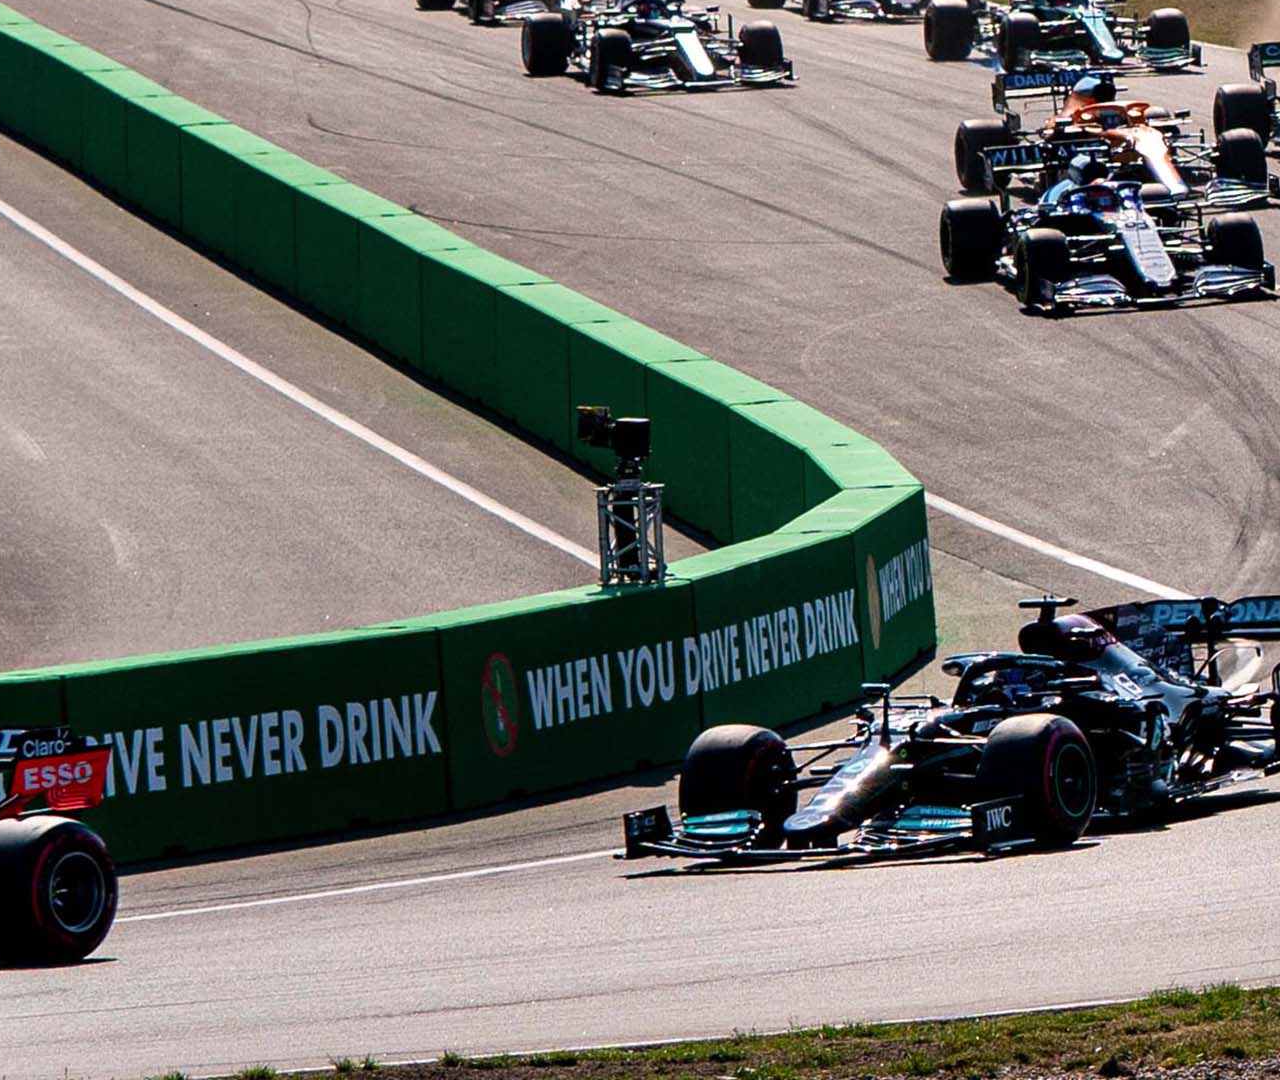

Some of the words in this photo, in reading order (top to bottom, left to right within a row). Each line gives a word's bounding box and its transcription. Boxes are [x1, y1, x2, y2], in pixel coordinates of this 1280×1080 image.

[878, 552, 907, 623] WHEN
[527, 652, 613, 730] WHEN
[617, 641, 676, 708] YOU
[683, 624, 741, 697] DRIVE
[743, 605, 800, 678] NEVER
[803, 587, 859, 659] DRINK
[22, 739, 66, 758] Claro
[85, 726, 168, 797] IVE
[180, 709, 308, 788] NEVER
[318, 690, 443, 769] DRINK
[23, 760, 94, 791] ESSO
[986, 805, 1013, 832] IWC
